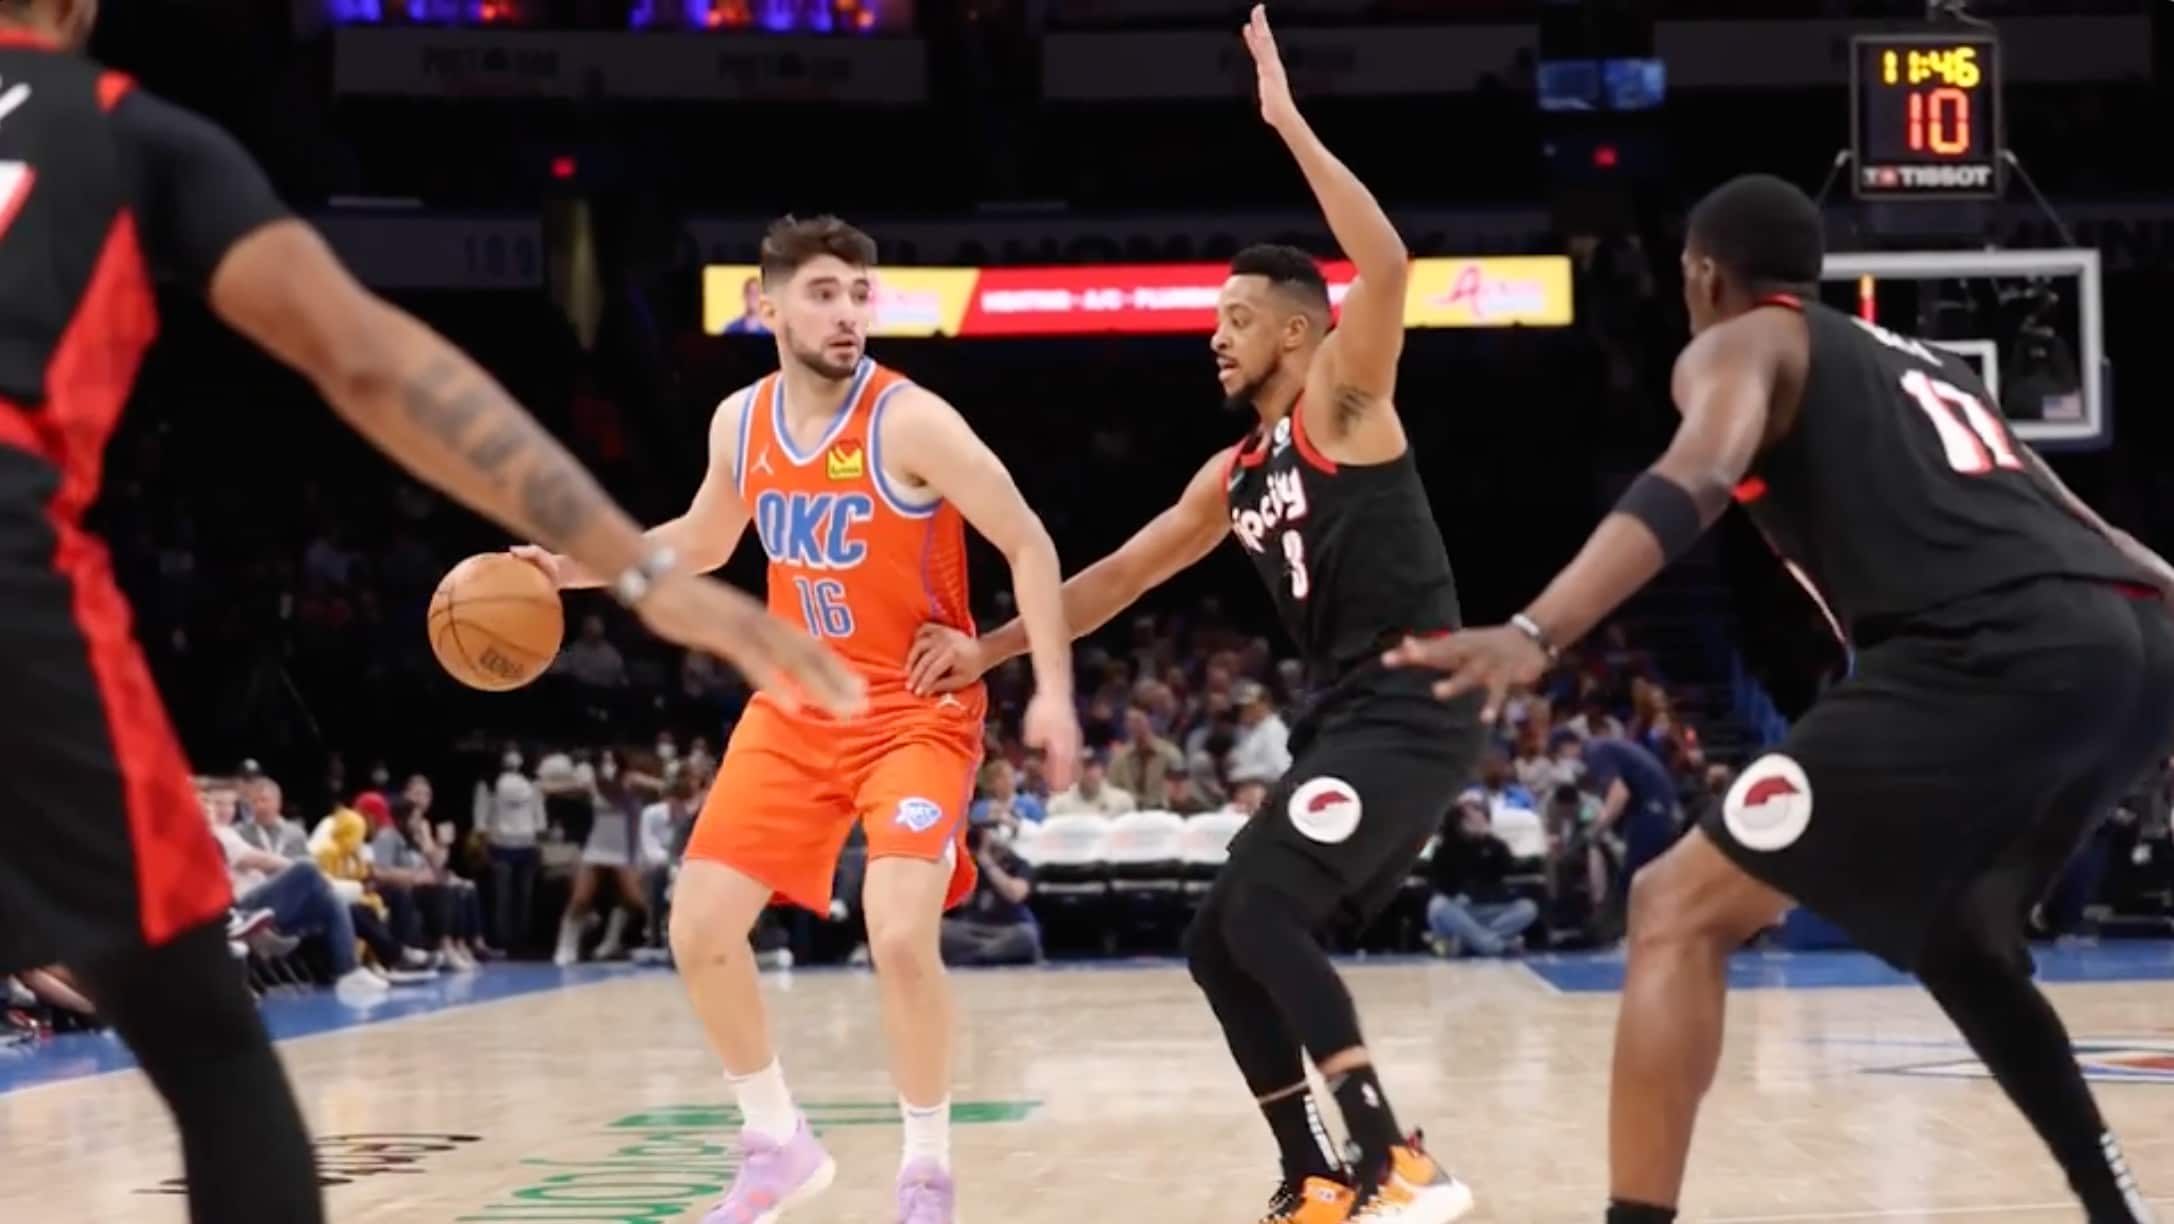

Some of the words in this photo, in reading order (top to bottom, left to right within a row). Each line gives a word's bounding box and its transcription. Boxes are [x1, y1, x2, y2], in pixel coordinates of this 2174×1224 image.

[1884, 46, 1980, 88] 11:46
[1909, 88, 1969, 154] 10
[1898, 164, 1992, 188] TISSOT
[757, 489, 875, 570] OKC
[1282, 529, 1310, 599] 3
[793, 575, 856, 640] 16
